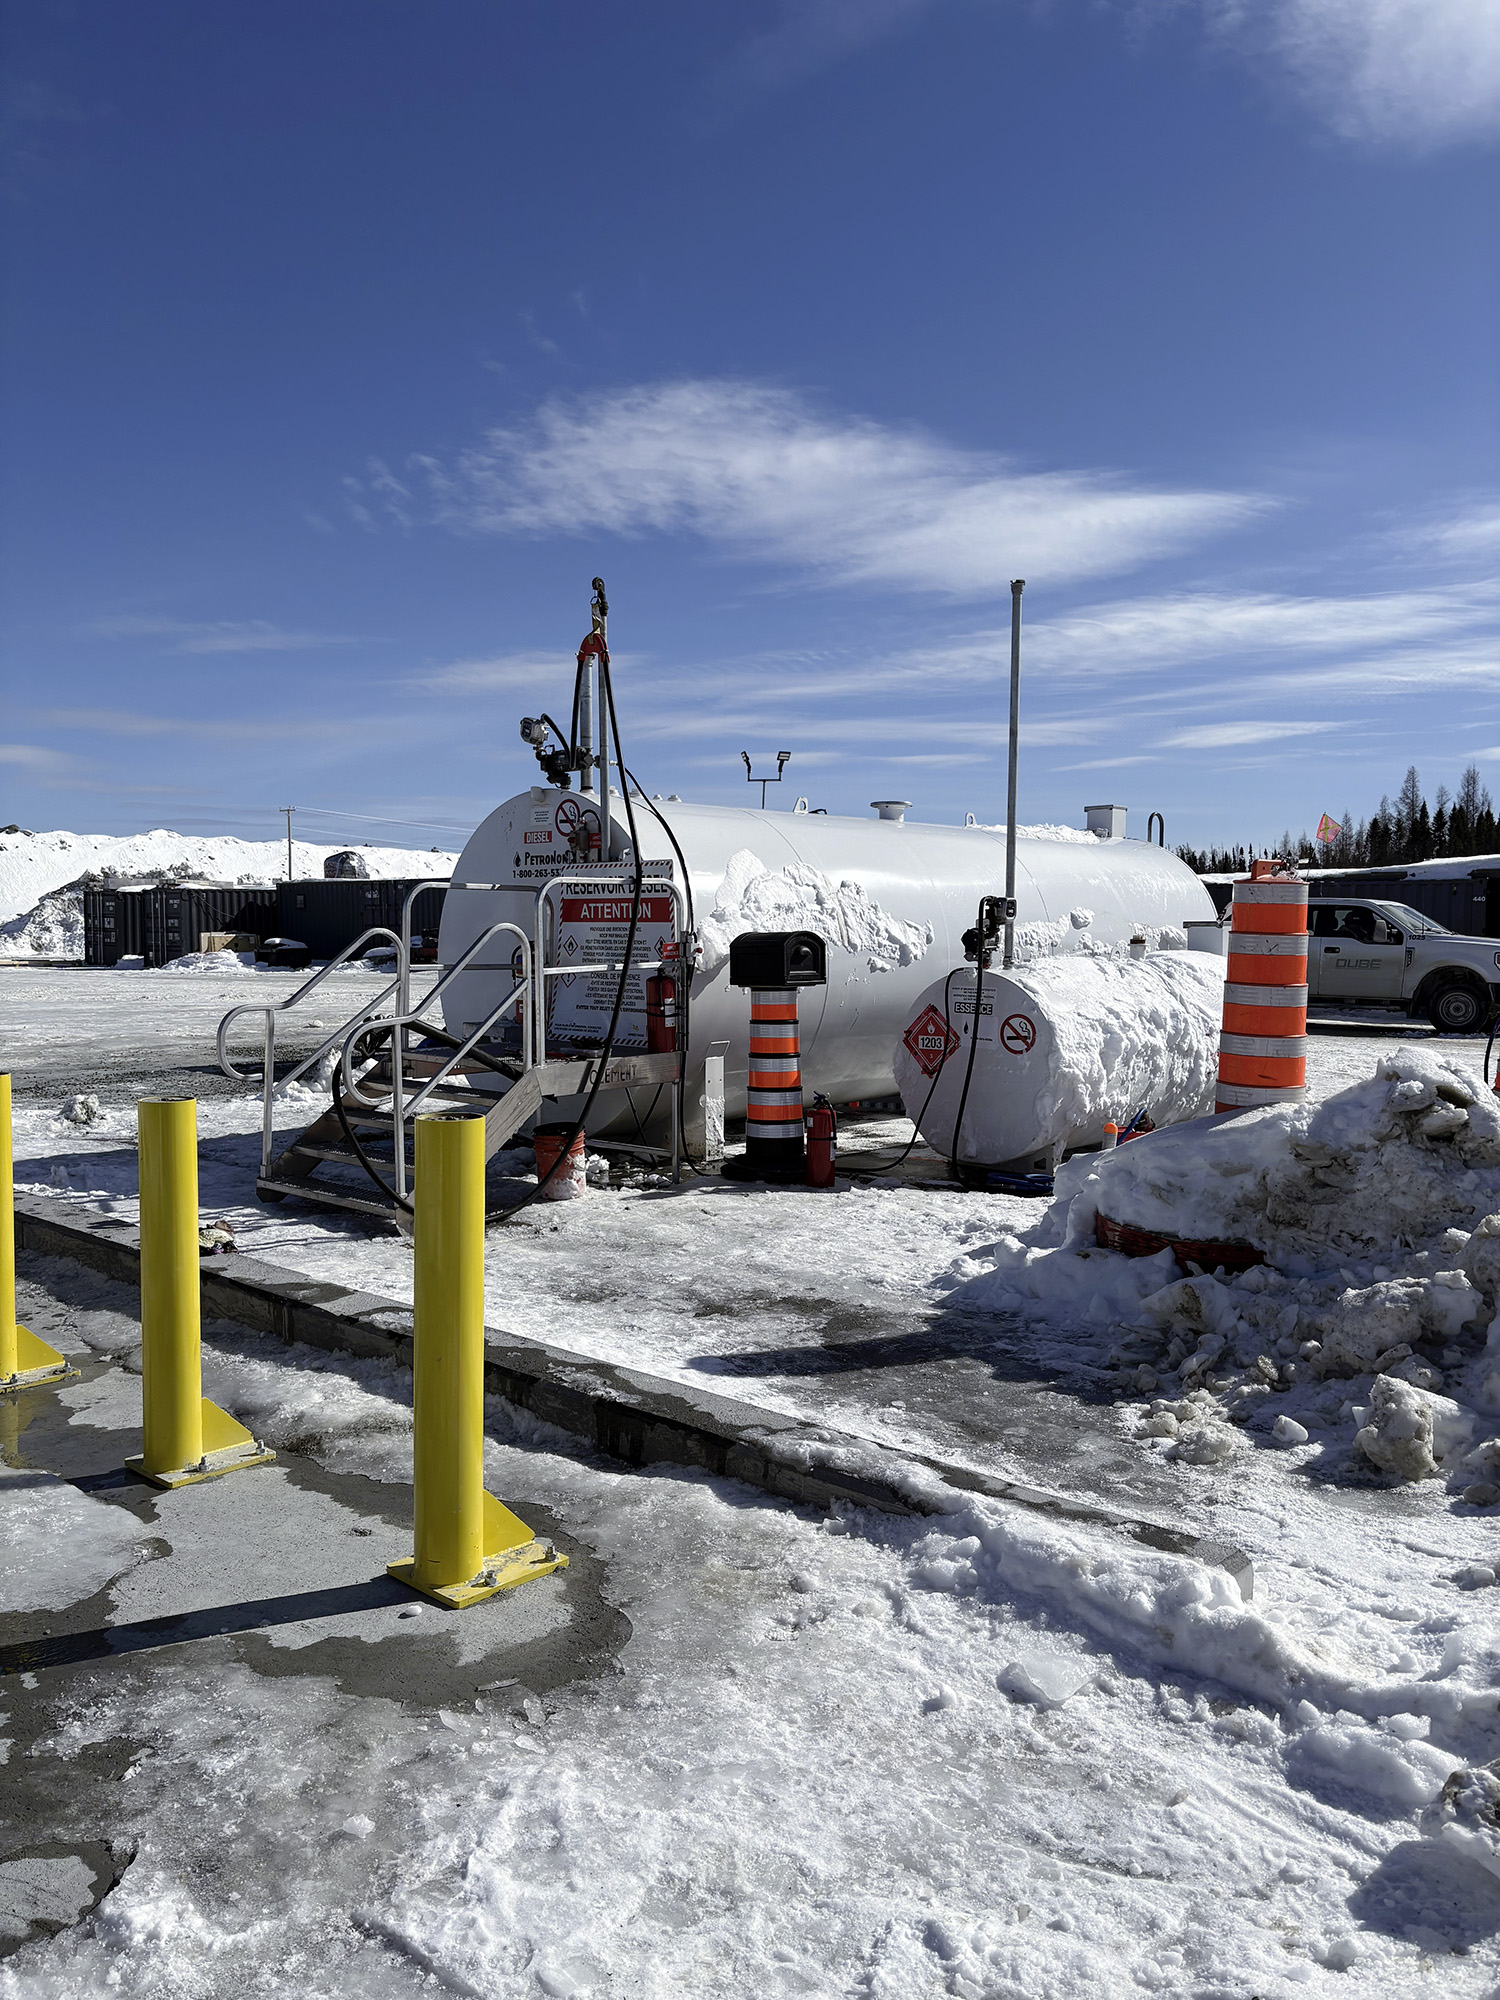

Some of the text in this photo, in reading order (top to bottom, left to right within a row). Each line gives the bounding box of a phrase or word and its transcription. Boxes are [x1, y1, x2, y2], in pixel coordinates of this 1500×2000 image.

[526, 832, 550, 843] DIESEL
[512, 868, 562, 878] 1-800-263-53
[955, 1003, 992, 1014] ESSECE
[920, 1036, 943, 1049] 1203
